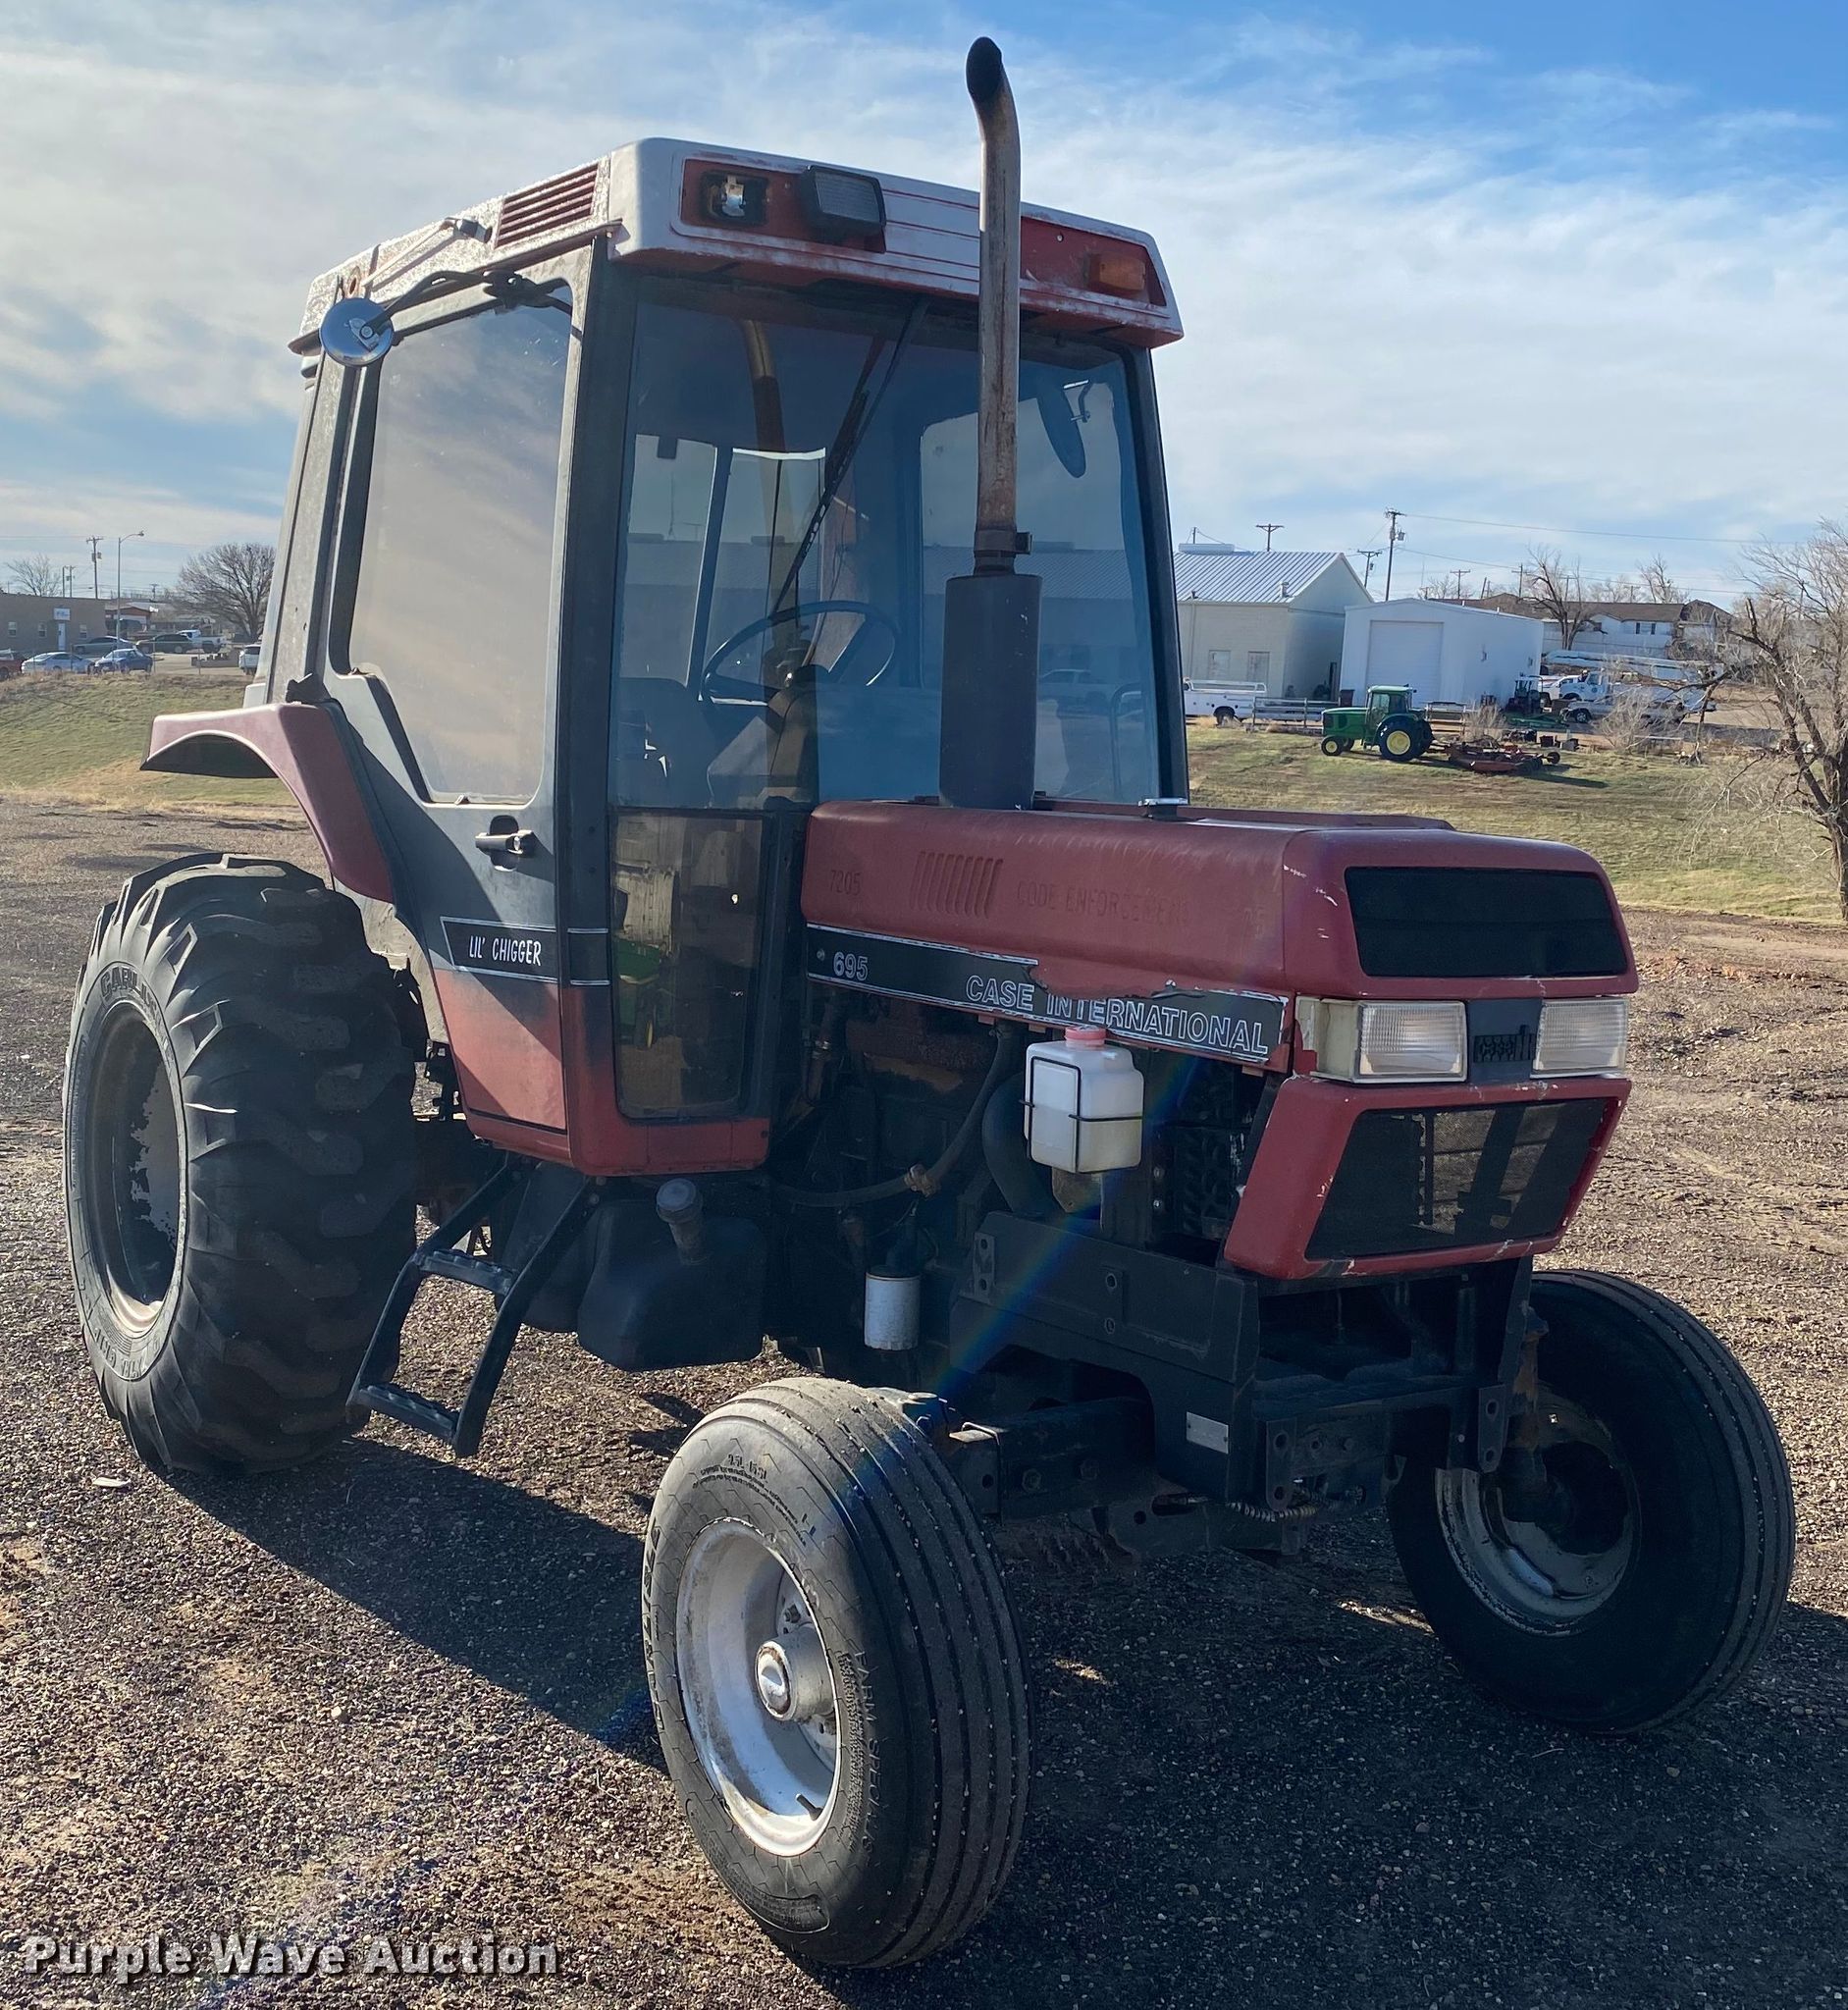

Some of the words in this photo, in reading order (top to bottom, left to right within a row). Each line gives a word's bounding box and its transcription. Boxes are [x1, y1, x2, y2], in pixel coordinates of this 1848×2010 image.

[1017, 880, 1057, 911] CODE
[492, 937, 542, 967] CHIGGER
[832, 951, 870, 981] 695
[966, 975, 1035, 1012] CASE
[1045, 993, 1269, 1055] INTERNATIONAL
